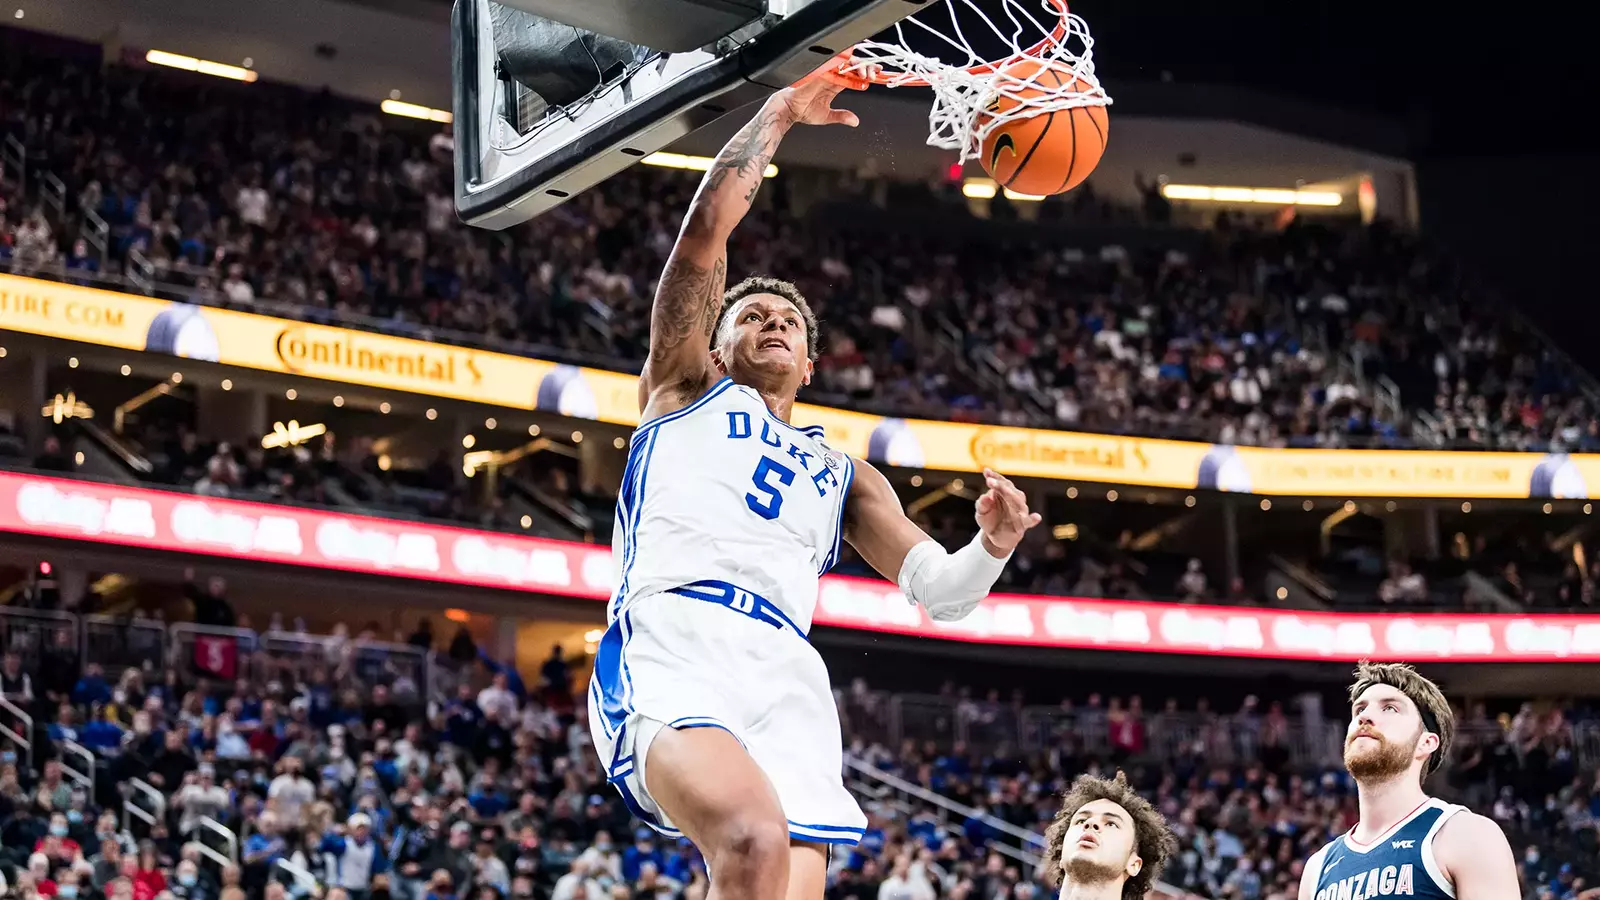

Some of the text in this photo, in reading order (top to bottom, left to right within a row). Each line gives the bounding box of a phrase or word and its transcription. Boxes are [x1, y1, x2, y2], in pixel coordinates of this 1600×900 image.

[274, 330, 454, 382] Continental
[726, 411, 838, 497] DUKE
[745, 455, 796, 520] 5
[729, 587, 754, 613] D
